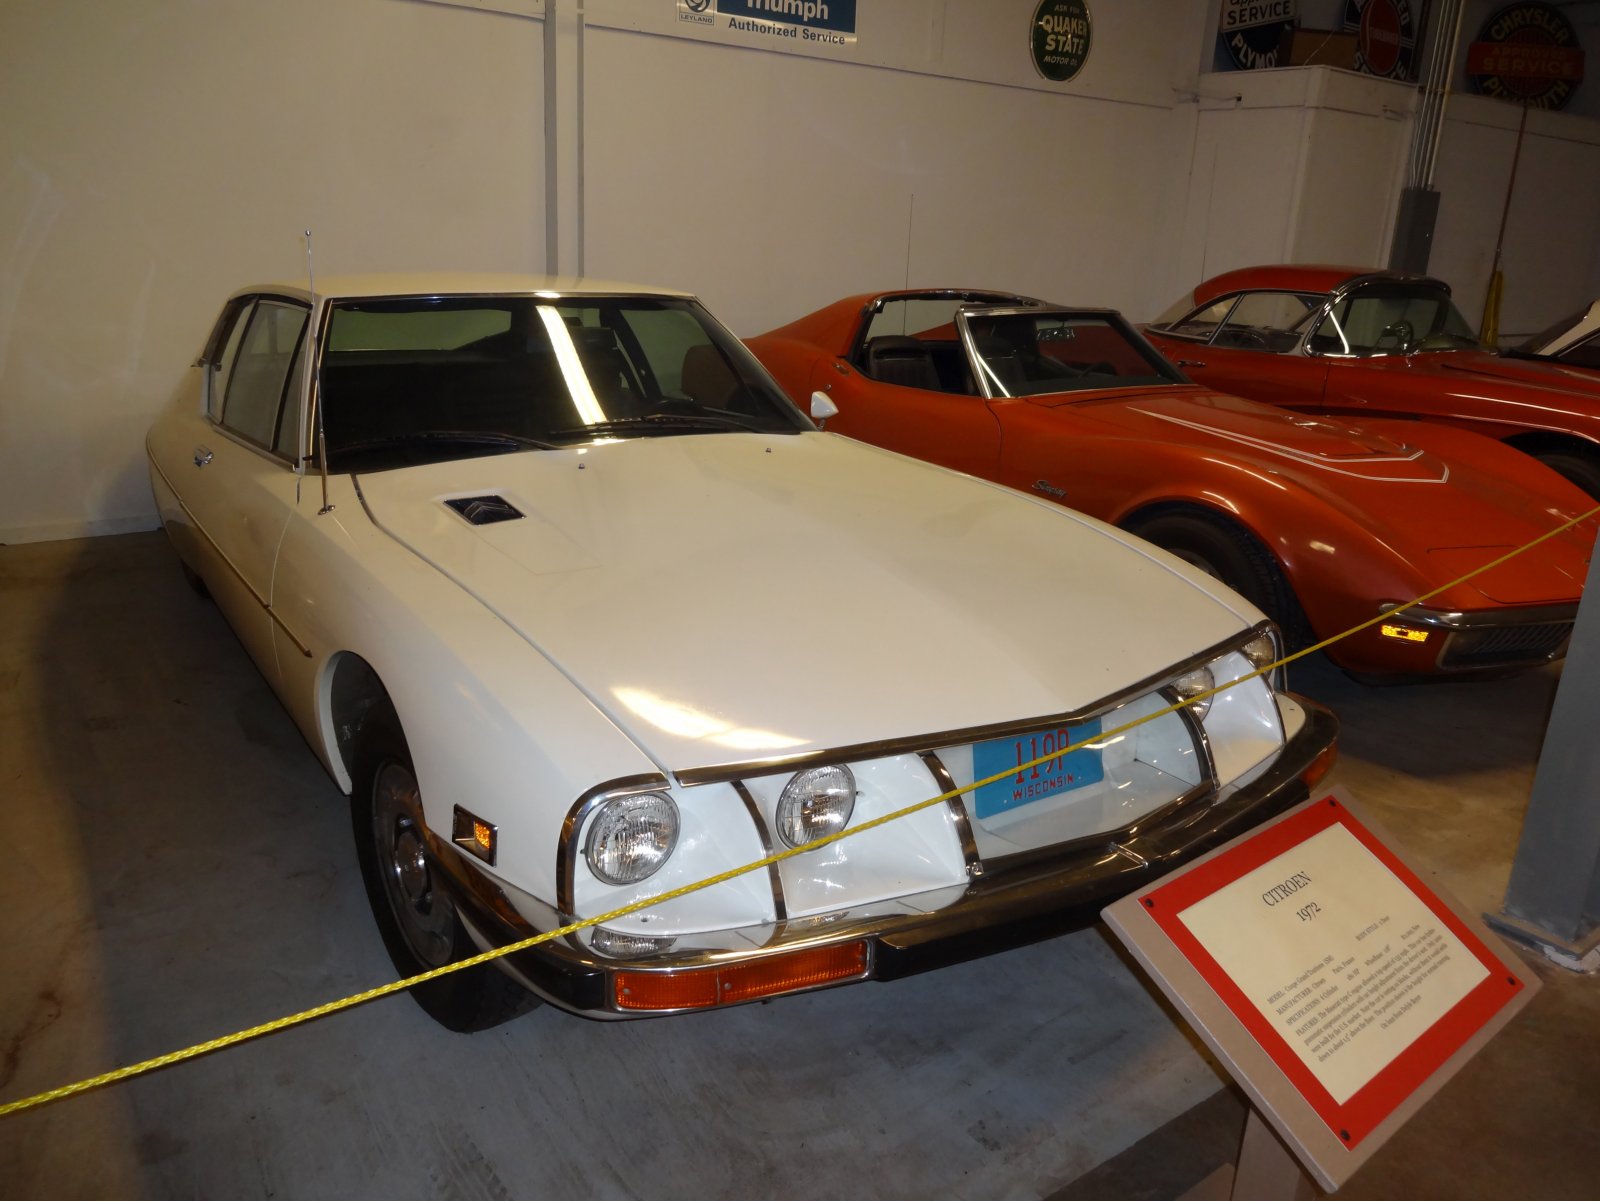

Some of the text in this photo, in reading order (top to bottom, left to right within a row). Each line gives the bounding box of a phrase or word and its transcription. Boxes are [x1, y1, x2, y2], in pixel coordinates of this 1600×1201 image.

[680, 14, 713, 25] LEYLAND
[1227, 0, 1291, 25] SERVICE
[728, 17, 845, 46] Authorized Service
[1042, 14, 1088, 38] QUAKER
[1490, 8, 1569, 45] CHRYSLER
[1044, 34, 1085, 55] STATE
[1231, 32, 1281, 69] PLYMO
[1043, 55, 1070, 65] MOTOR
[1482, 57, 1575, 76] SERVICE
[1013, 773, 1074, 801] WISCONSIN
[1261, 870, 1313, 907] CITROEN
[1295, 901, 1322, 922] 1972
